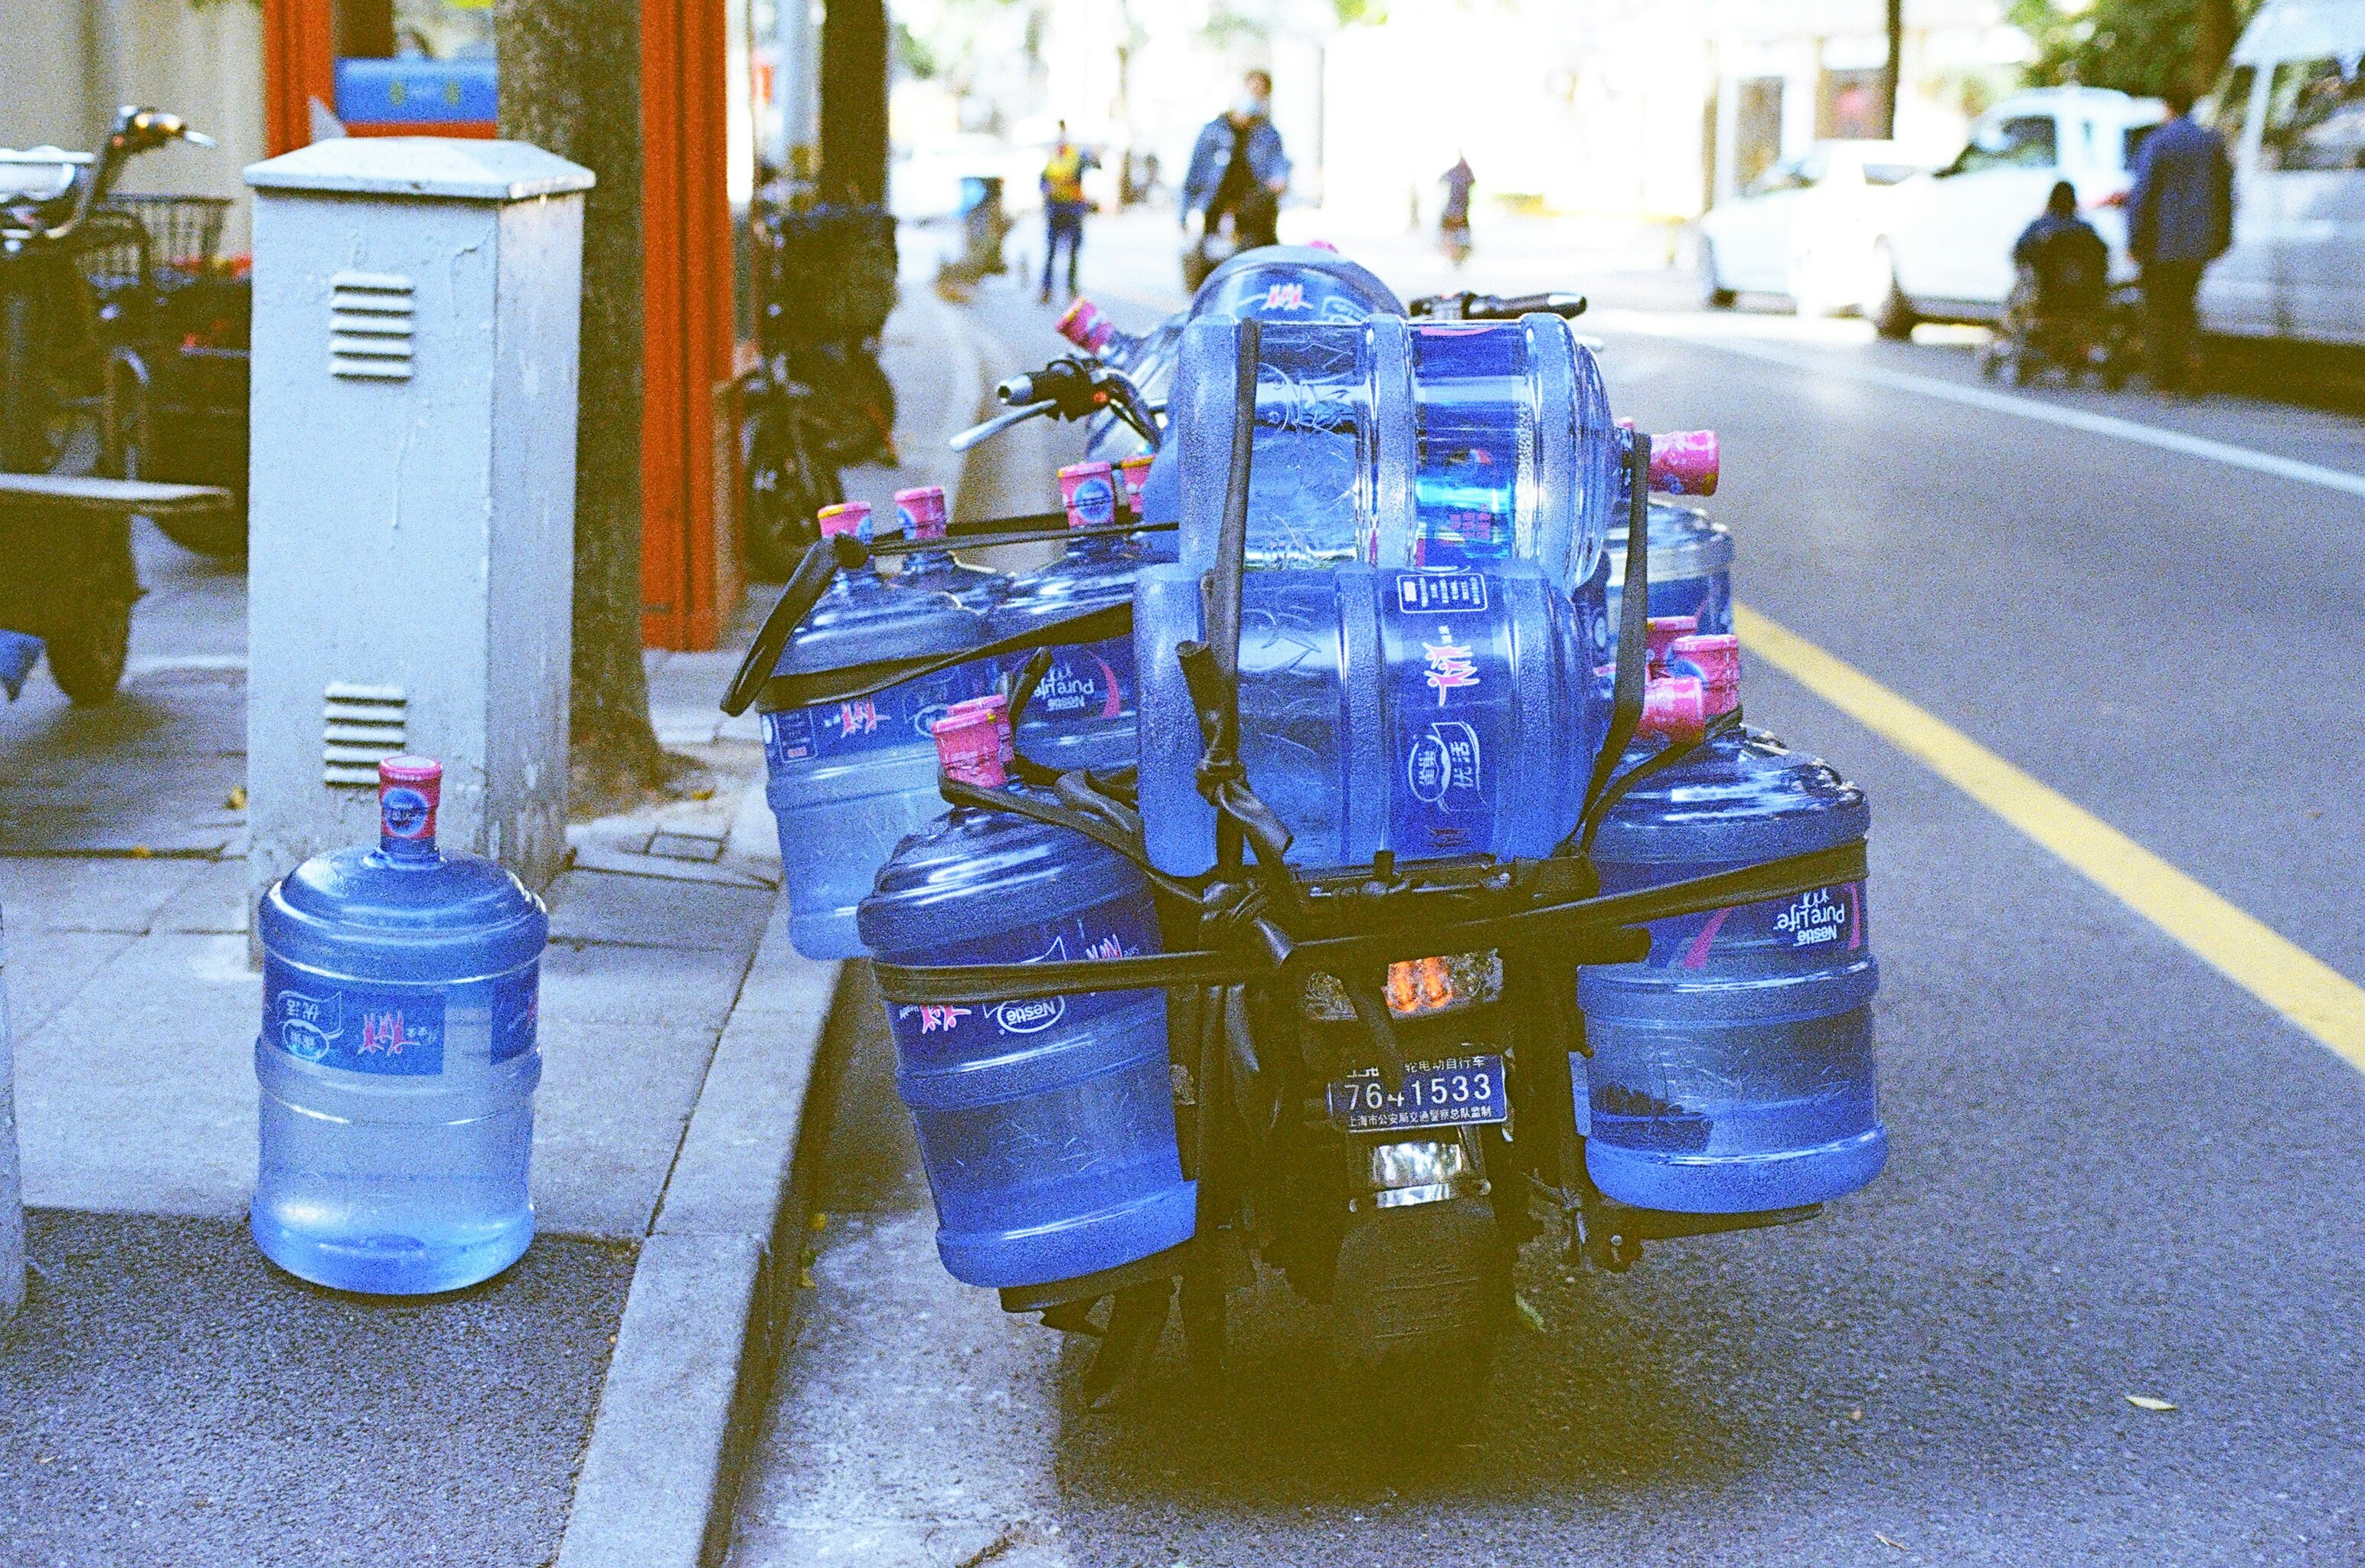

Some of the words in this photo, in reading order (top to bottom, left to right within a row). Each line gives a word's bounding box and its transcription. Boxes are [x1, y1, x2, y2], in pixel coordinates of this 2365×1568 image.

[1451, 740, 1472, 789] 优活
[1777, 903, 1809, 932] Life
[1811, 903, 1845, 925] Pure
